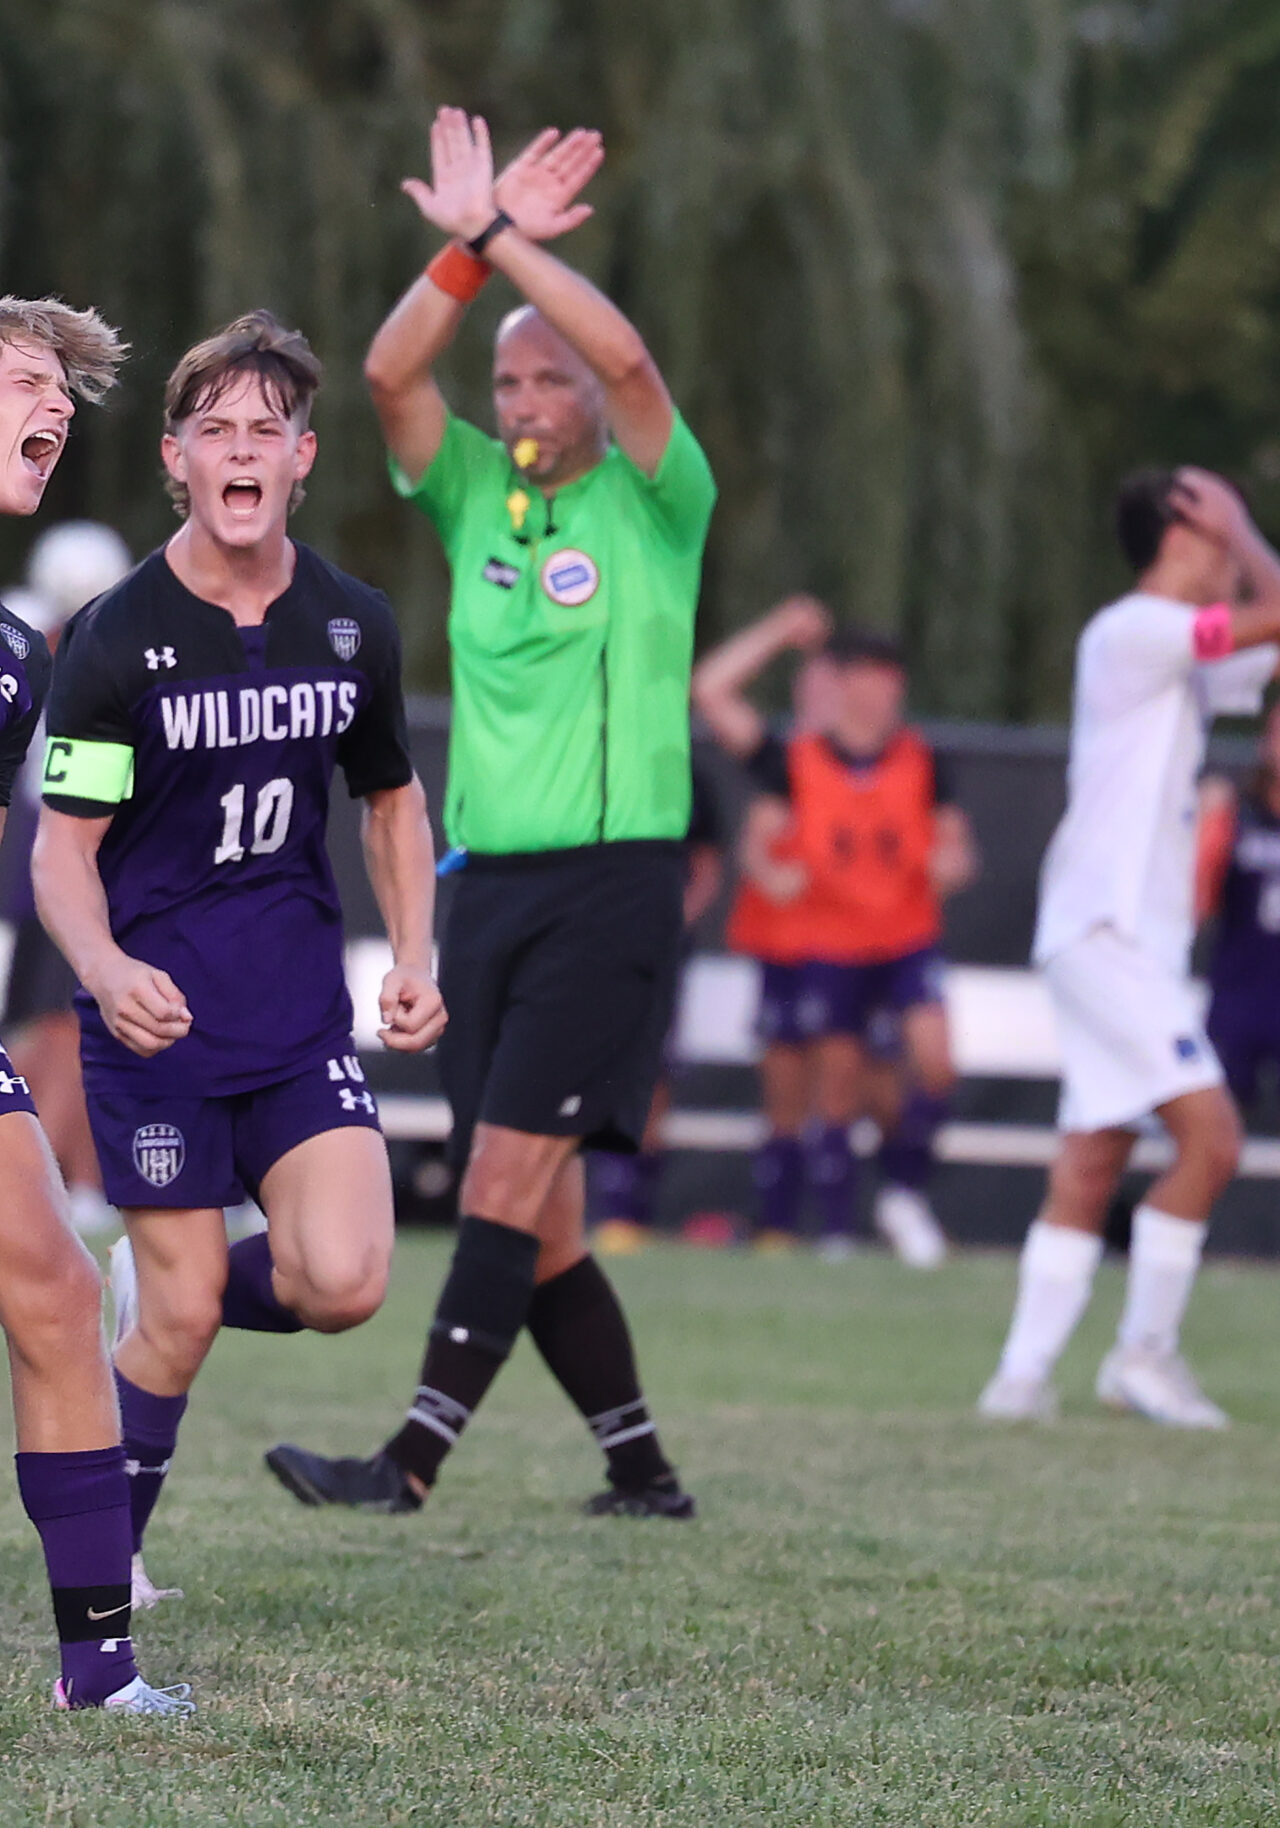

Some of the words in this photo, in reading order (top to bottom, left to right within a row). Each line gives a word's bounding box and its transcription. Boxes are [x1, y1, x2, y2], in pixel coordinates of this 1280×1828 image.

[161, 681, 357, 751] WILDCATS
[44, 741, 74, 783] C
[213, 777, 295, 865] 10
